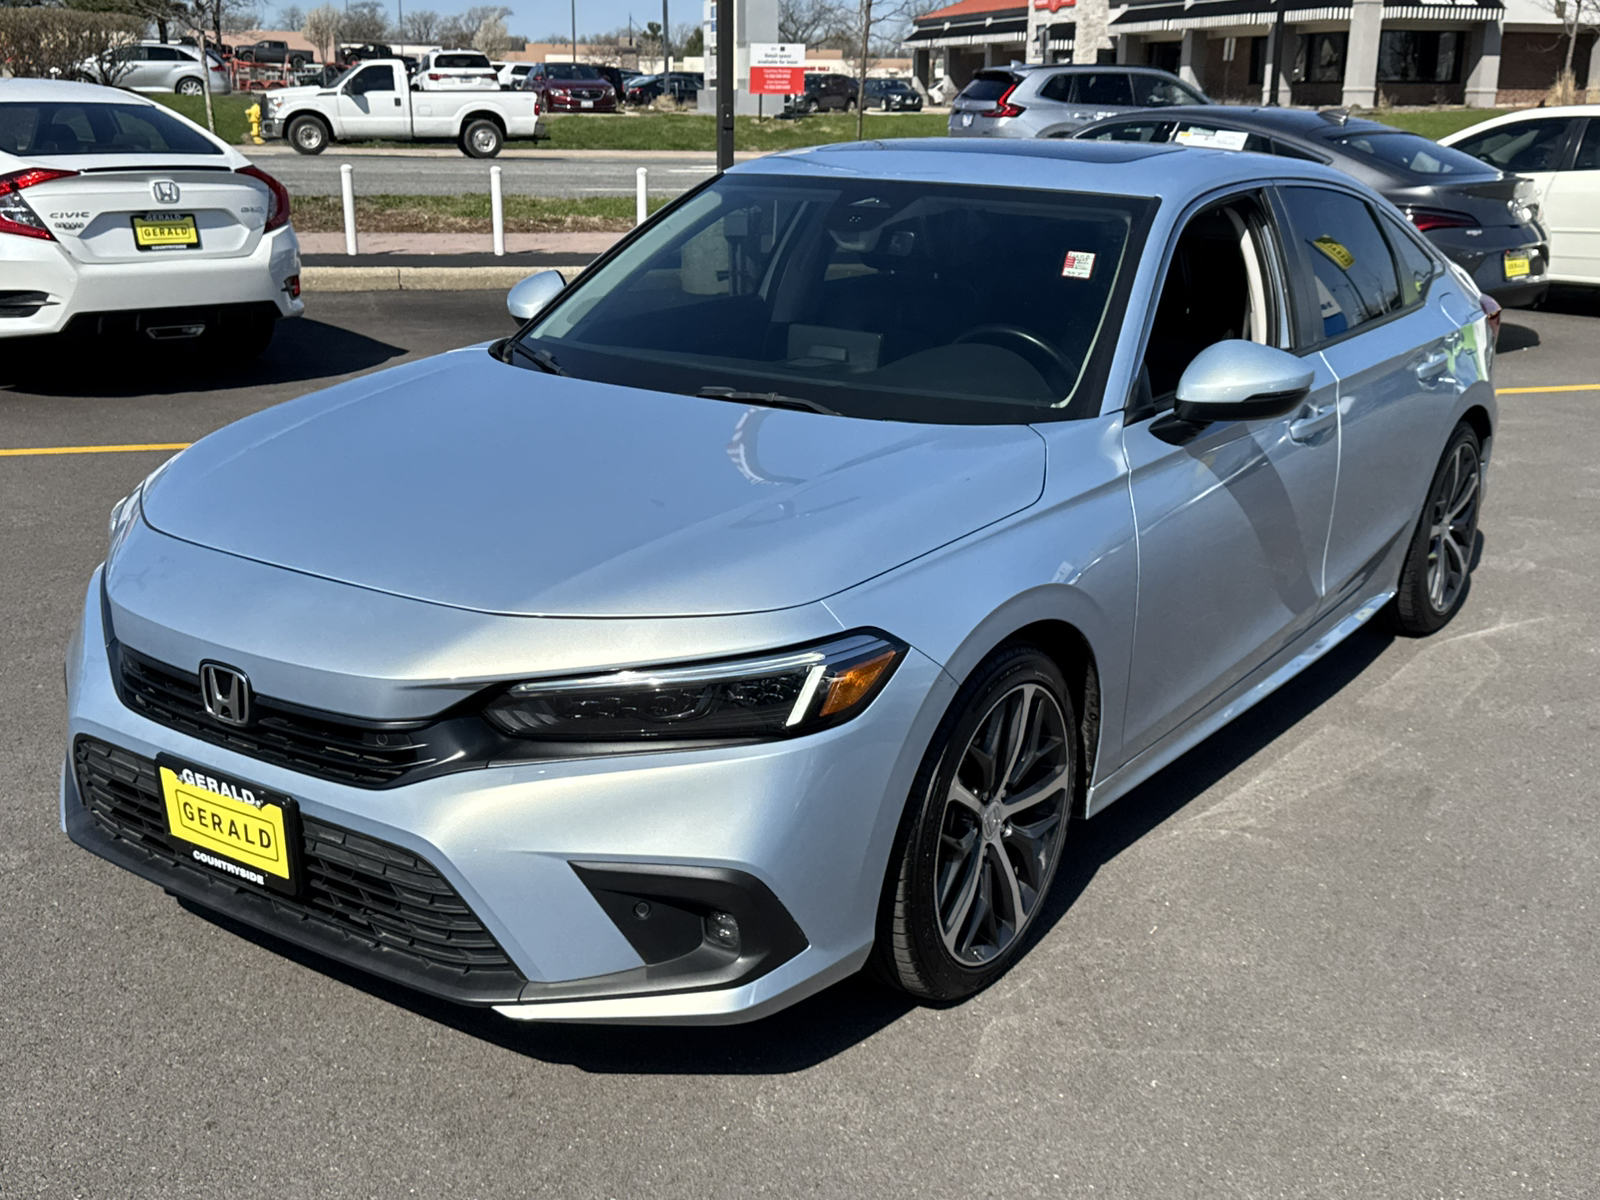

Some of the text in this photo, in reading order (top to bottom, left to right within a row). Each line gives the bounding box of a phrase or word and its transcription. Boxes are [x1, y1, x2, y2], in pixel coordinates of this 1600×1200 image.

[49, 211, 90, 219] CIVIC
[146, 213, 182, 221] GERALD
[144, 227, 188, 237] GERALD
[181, 768, 256, 806] GERALD
[182, 801, 272, 849] GERALD
[192, 850, 265, 886] COUNTRYSIDE
